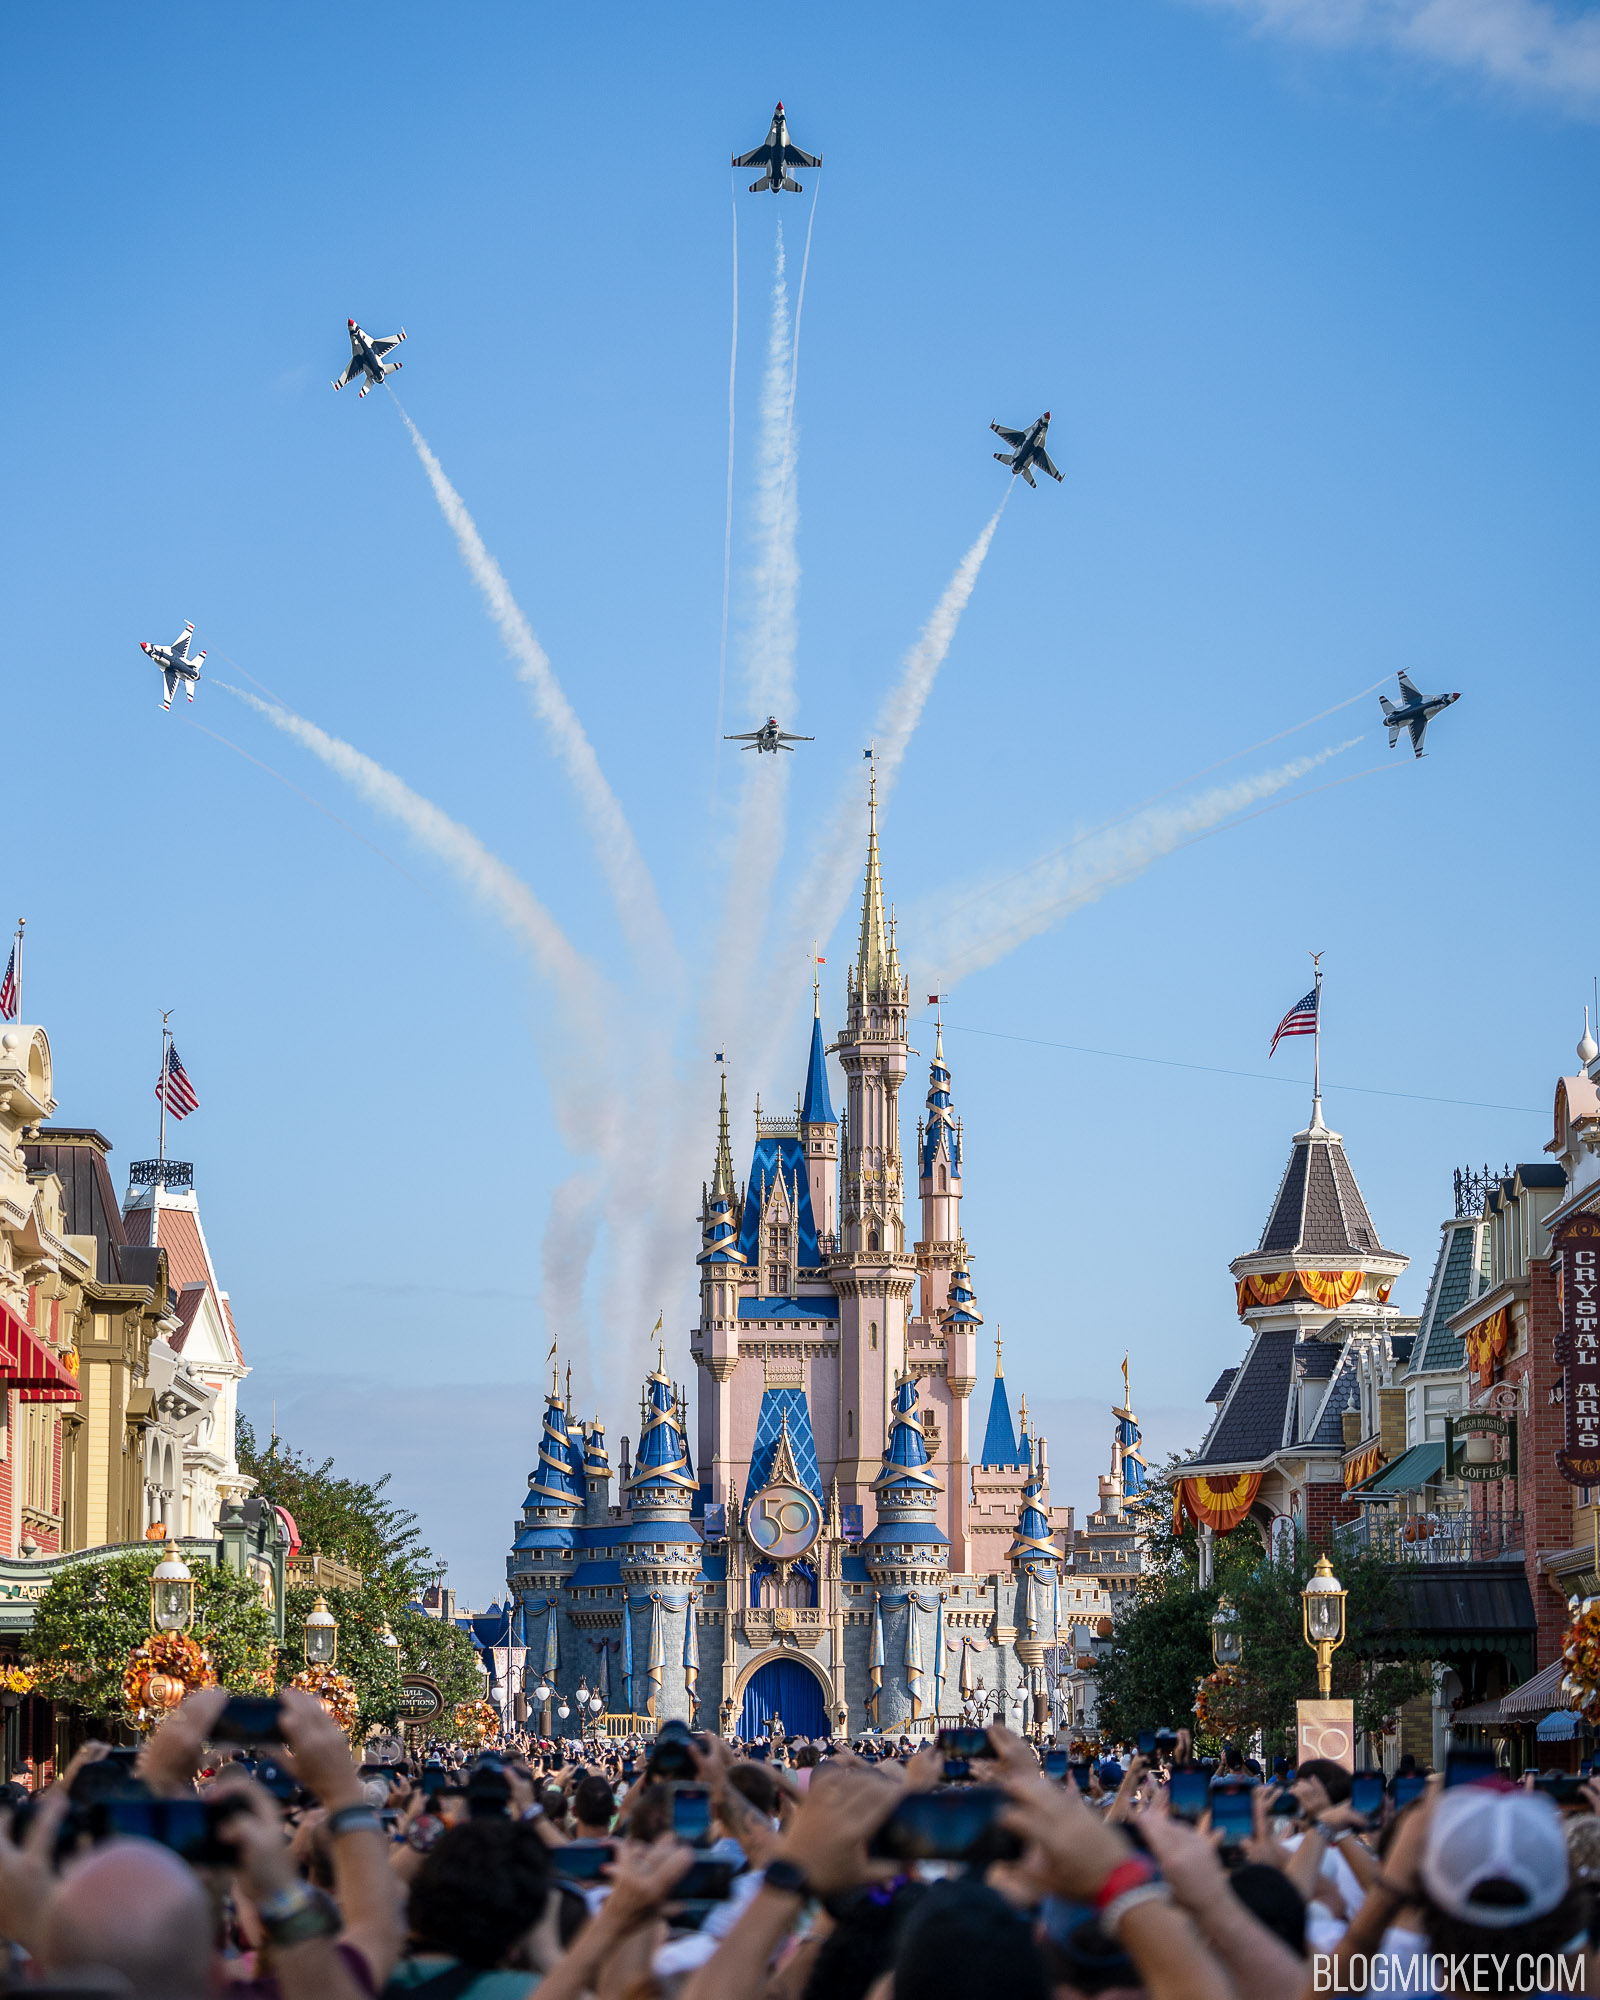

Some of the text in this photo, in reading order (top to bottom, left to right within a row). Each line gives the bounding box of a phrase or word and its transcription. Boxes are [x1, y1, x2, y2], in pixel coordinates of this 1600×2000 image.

[1574, 1251, 1600, 1448] CRYSTAL ARTS
[1457, 1418, 1505, 1432] FRESH ROASTED
[1460, 1465, 1504, 1479] COFFEE
[764, 1497, 812, 1549] 50
